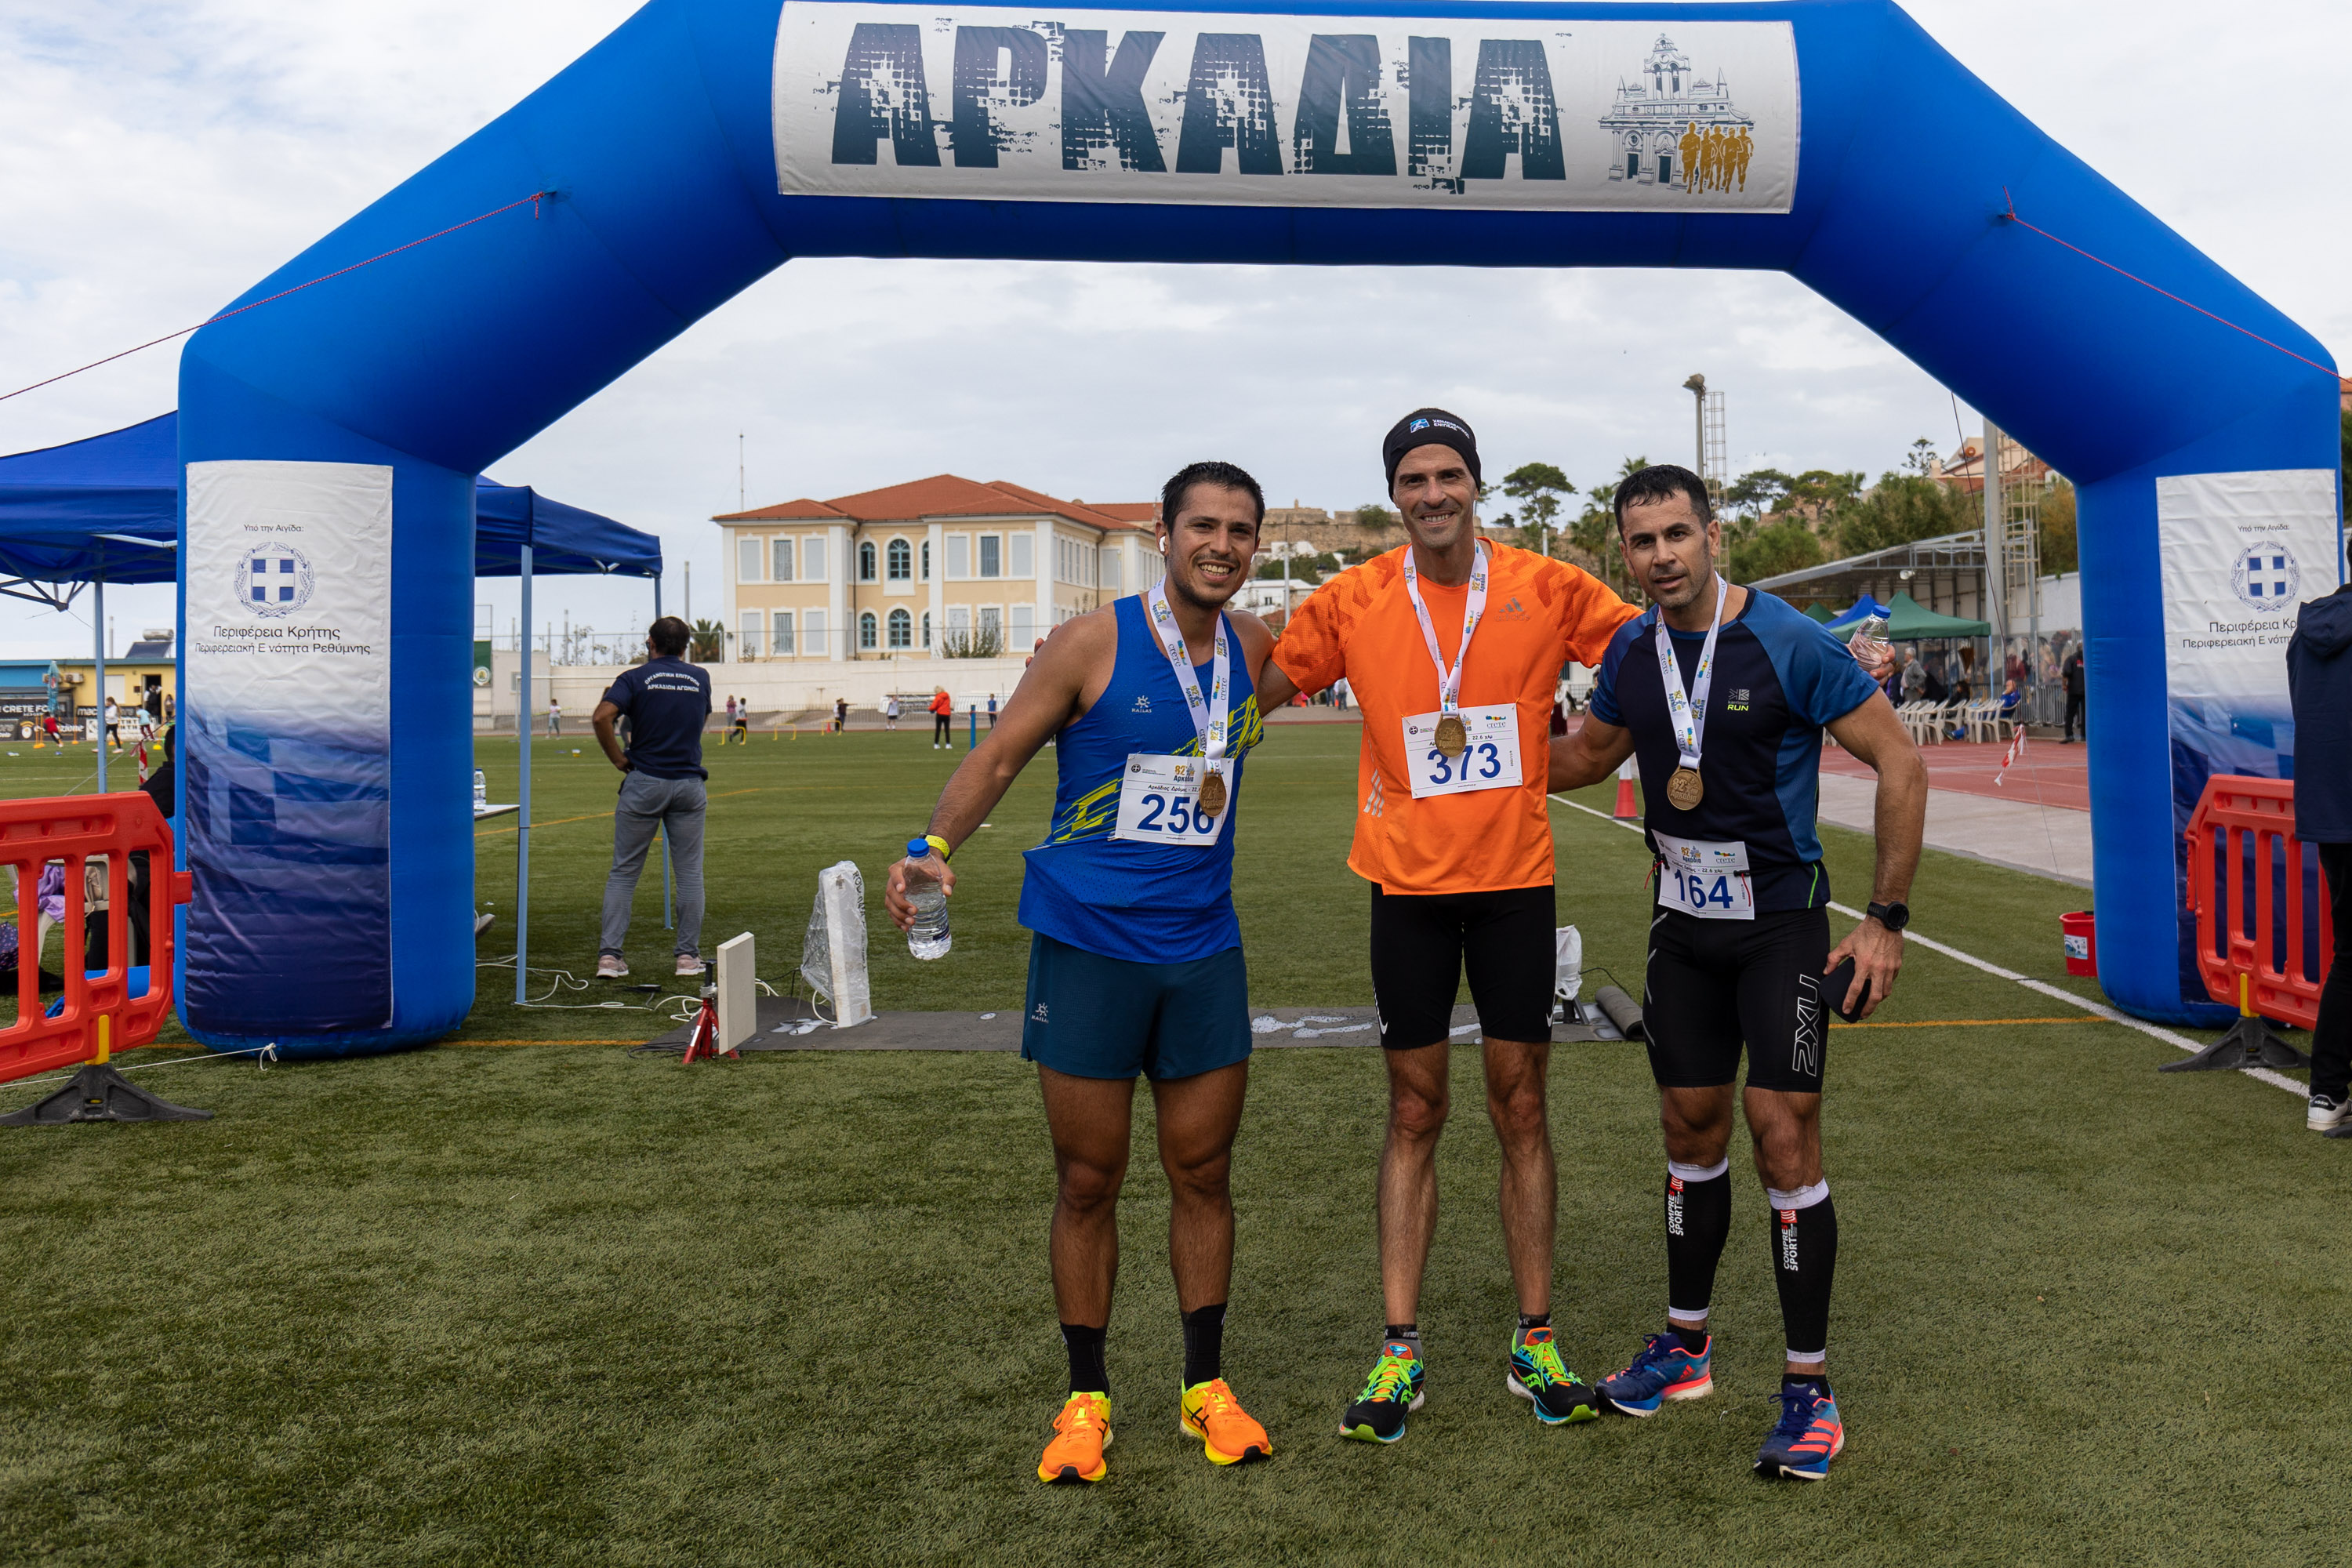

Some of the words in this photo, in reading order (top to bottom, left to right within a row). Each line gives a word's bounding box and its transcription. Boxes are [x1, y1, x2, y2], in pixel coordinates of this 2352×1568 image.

[829, 22, 1568, 182] ΑΡΚΑΔΙΑ
[244, 524, 258, 532] Υπό
[260, 524, 273, 533] την
[276, 524, 304, 533] Αιγίδα:
[2267, 523, 2290, 532] Αιγίδα:
[213, 625, 283, 639] Περιφέρεια
[288, 625, 340, 640] Κρήτης
[2209, 619, 2280, 633] Περιφέρεια
[194, 642, 255, 654] Περιφερειακή
[313, 643, 371, 655] Ρεθύμνης
[2183, 636, 2256, 649] Περιφερειακή
[1428, 742, 1501, 785] 373
[1137, 793, 1214, 834] 256
[1675, 869, 1733, 909] 164
[1792, 974, 1820, 1077] 2XU
[1674, 1204, 1684, 1236] SPORT
[1789, 1237, 1798, 1272] SPORT
